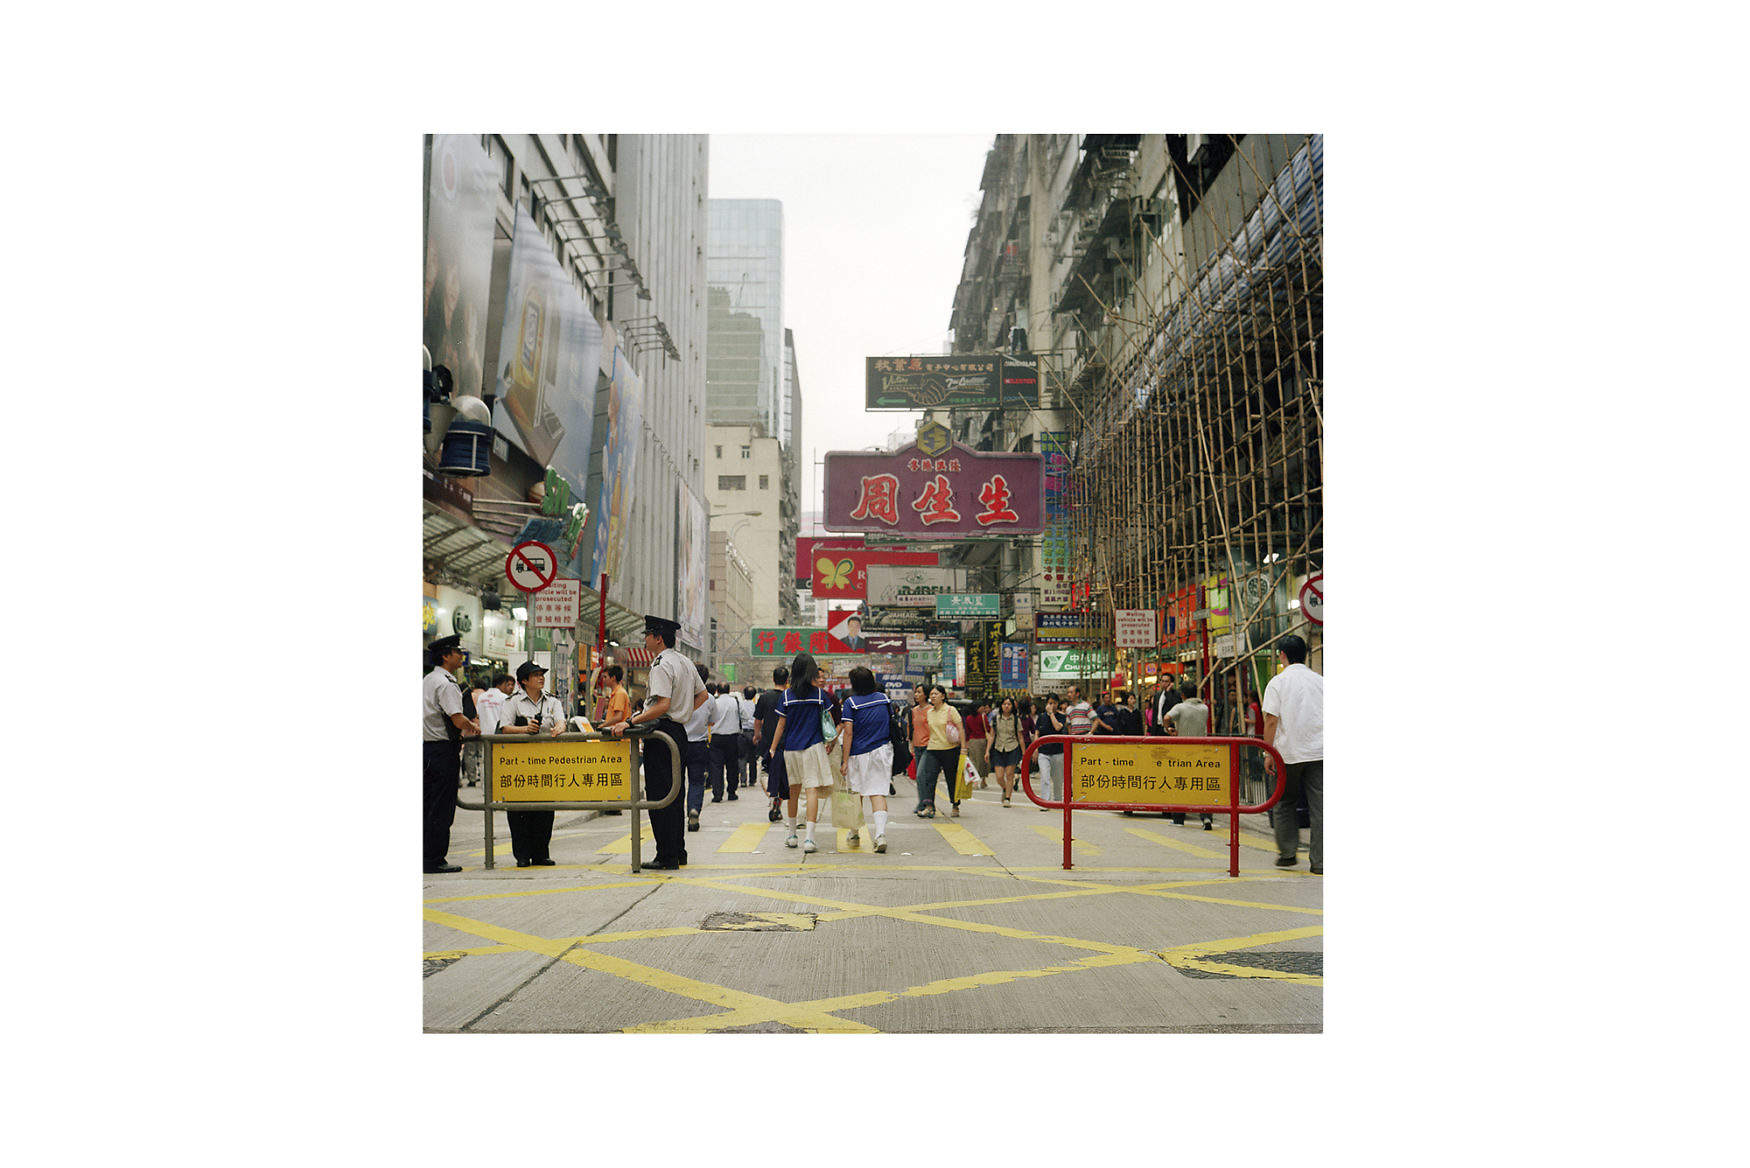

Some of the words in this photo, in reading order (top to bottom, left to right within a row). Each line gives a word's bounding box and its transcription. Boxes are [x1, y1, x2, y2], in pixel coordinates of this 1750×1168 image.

[850, 472, 1019, 526] 周生生
[499, 757, 518, 765] Part
[528, 757, 546, 765] time
[549, 755, 597, 765] Pedestrian
[600, 755, 622, 764] Area
[1080, 757, 1102, 766] Part
[1112, 757, 1134, 767] time
[1195, 759, 1221, 768] Area
[500, 773, 623, 788] 部份時間行人專用區
[1080, 774, 1221, 791] 部份時間行人專用區
